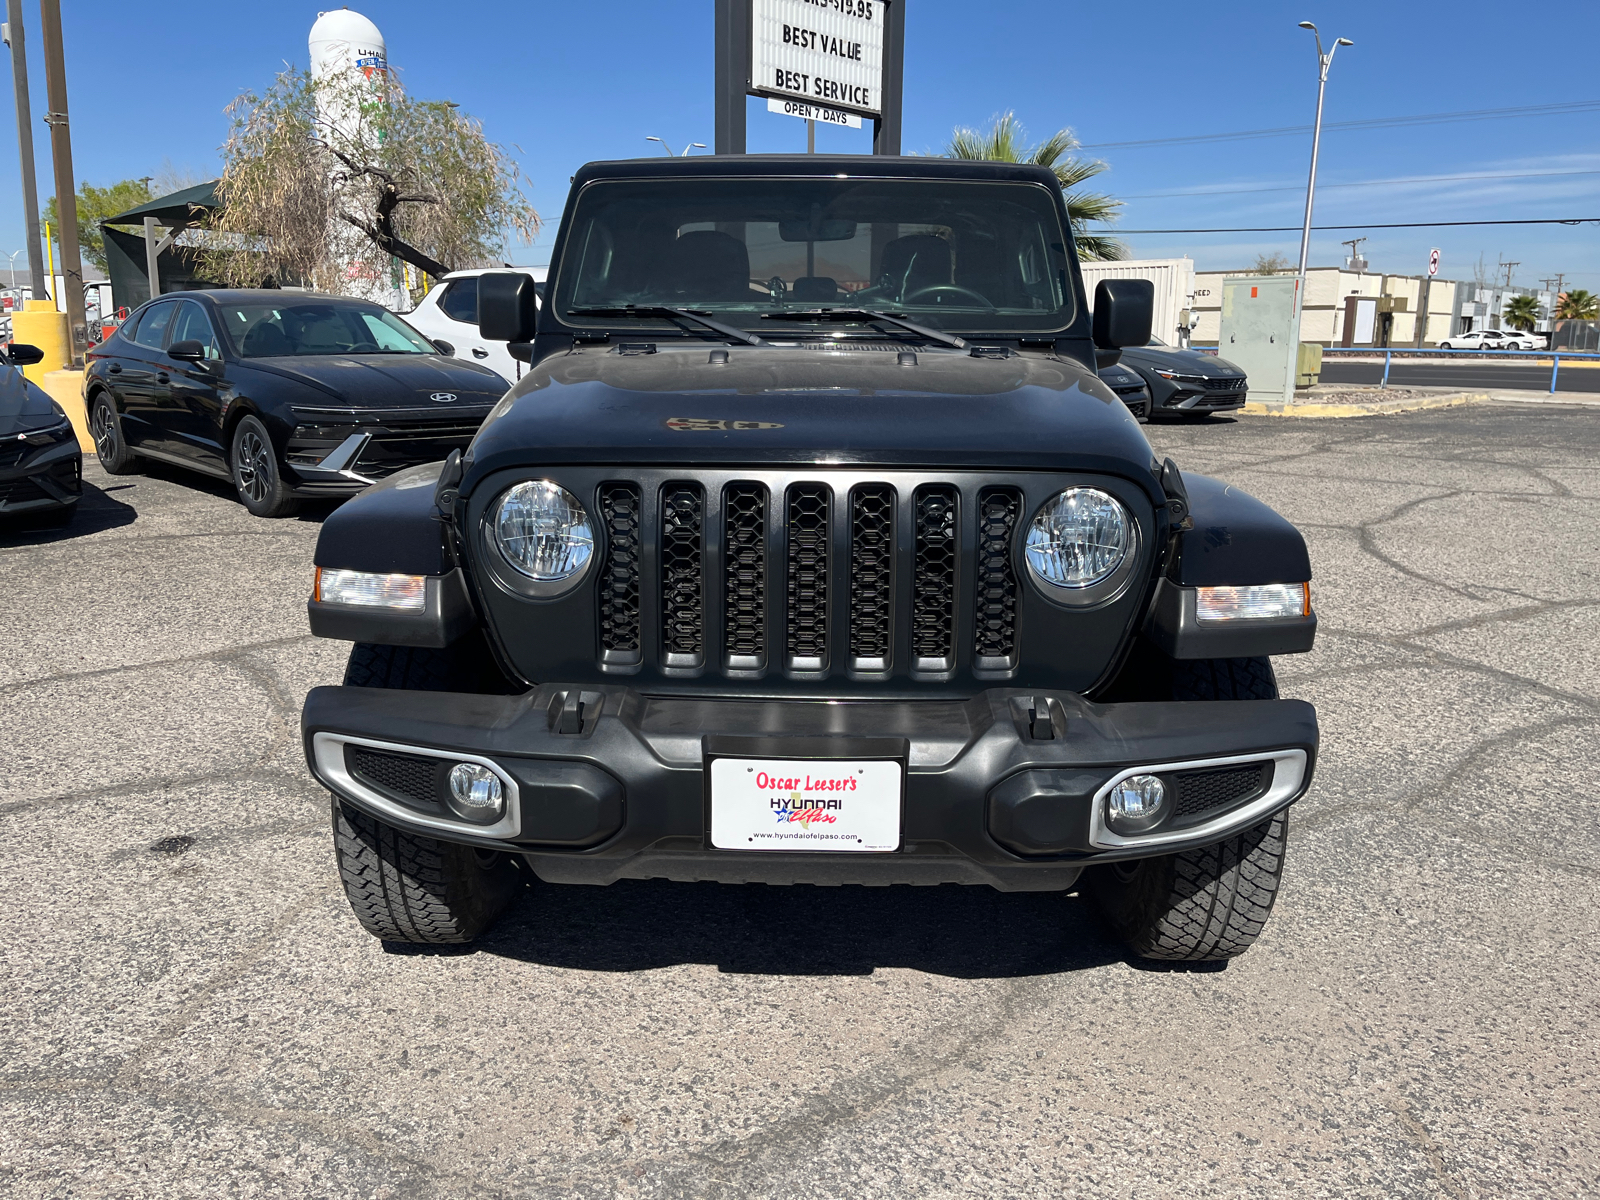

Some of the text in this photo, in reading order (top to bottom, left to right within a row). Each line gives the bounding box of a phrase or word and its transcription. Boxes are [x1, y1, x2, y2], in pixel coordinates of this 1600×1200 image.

[783, 24, 862, 61] BEST VALUE
[776, 68, 869, 105] BEST SERVICE
[784, 102, 847, 124] OPEN 7 DAYS
[756, 772, 857, 791] Oscar Leeser's
[770, 797, 842, 810] HYUNDAI
[789, 808, 811, 822] El
[806, 807, 837, 824] Paso
[753, 832, 858, 841] www.hyundaiofelpaso.com
